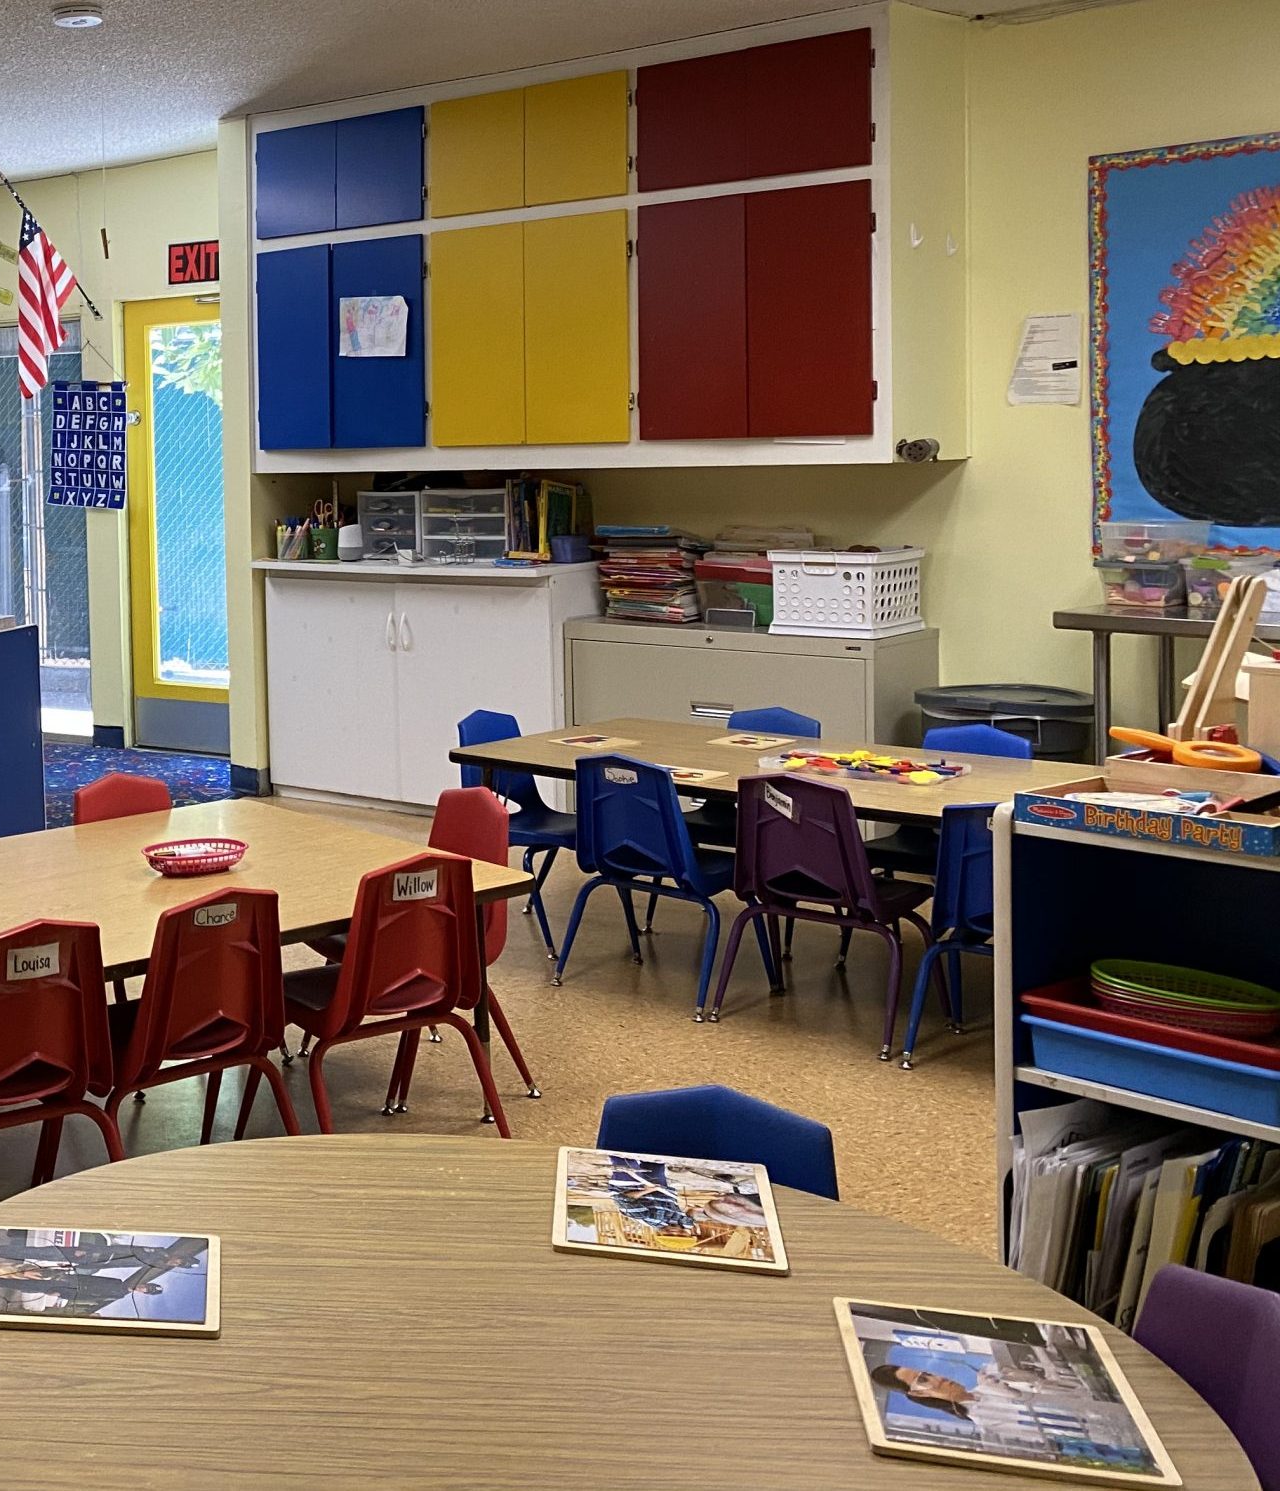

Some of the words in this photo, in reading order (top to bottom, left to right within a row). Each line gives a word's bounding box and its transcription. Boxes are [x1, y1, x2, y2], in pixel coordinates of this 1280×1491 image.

[171, 243, 218, 282] EXIT
[1084, 804, 1172, 841] Birthday
[1181, 818, 1244, 851] Party
[397, 876, 434, 896] Willow
[196, 909, 234, 924] Chance
[14, 954, 50, 973] Louisa
